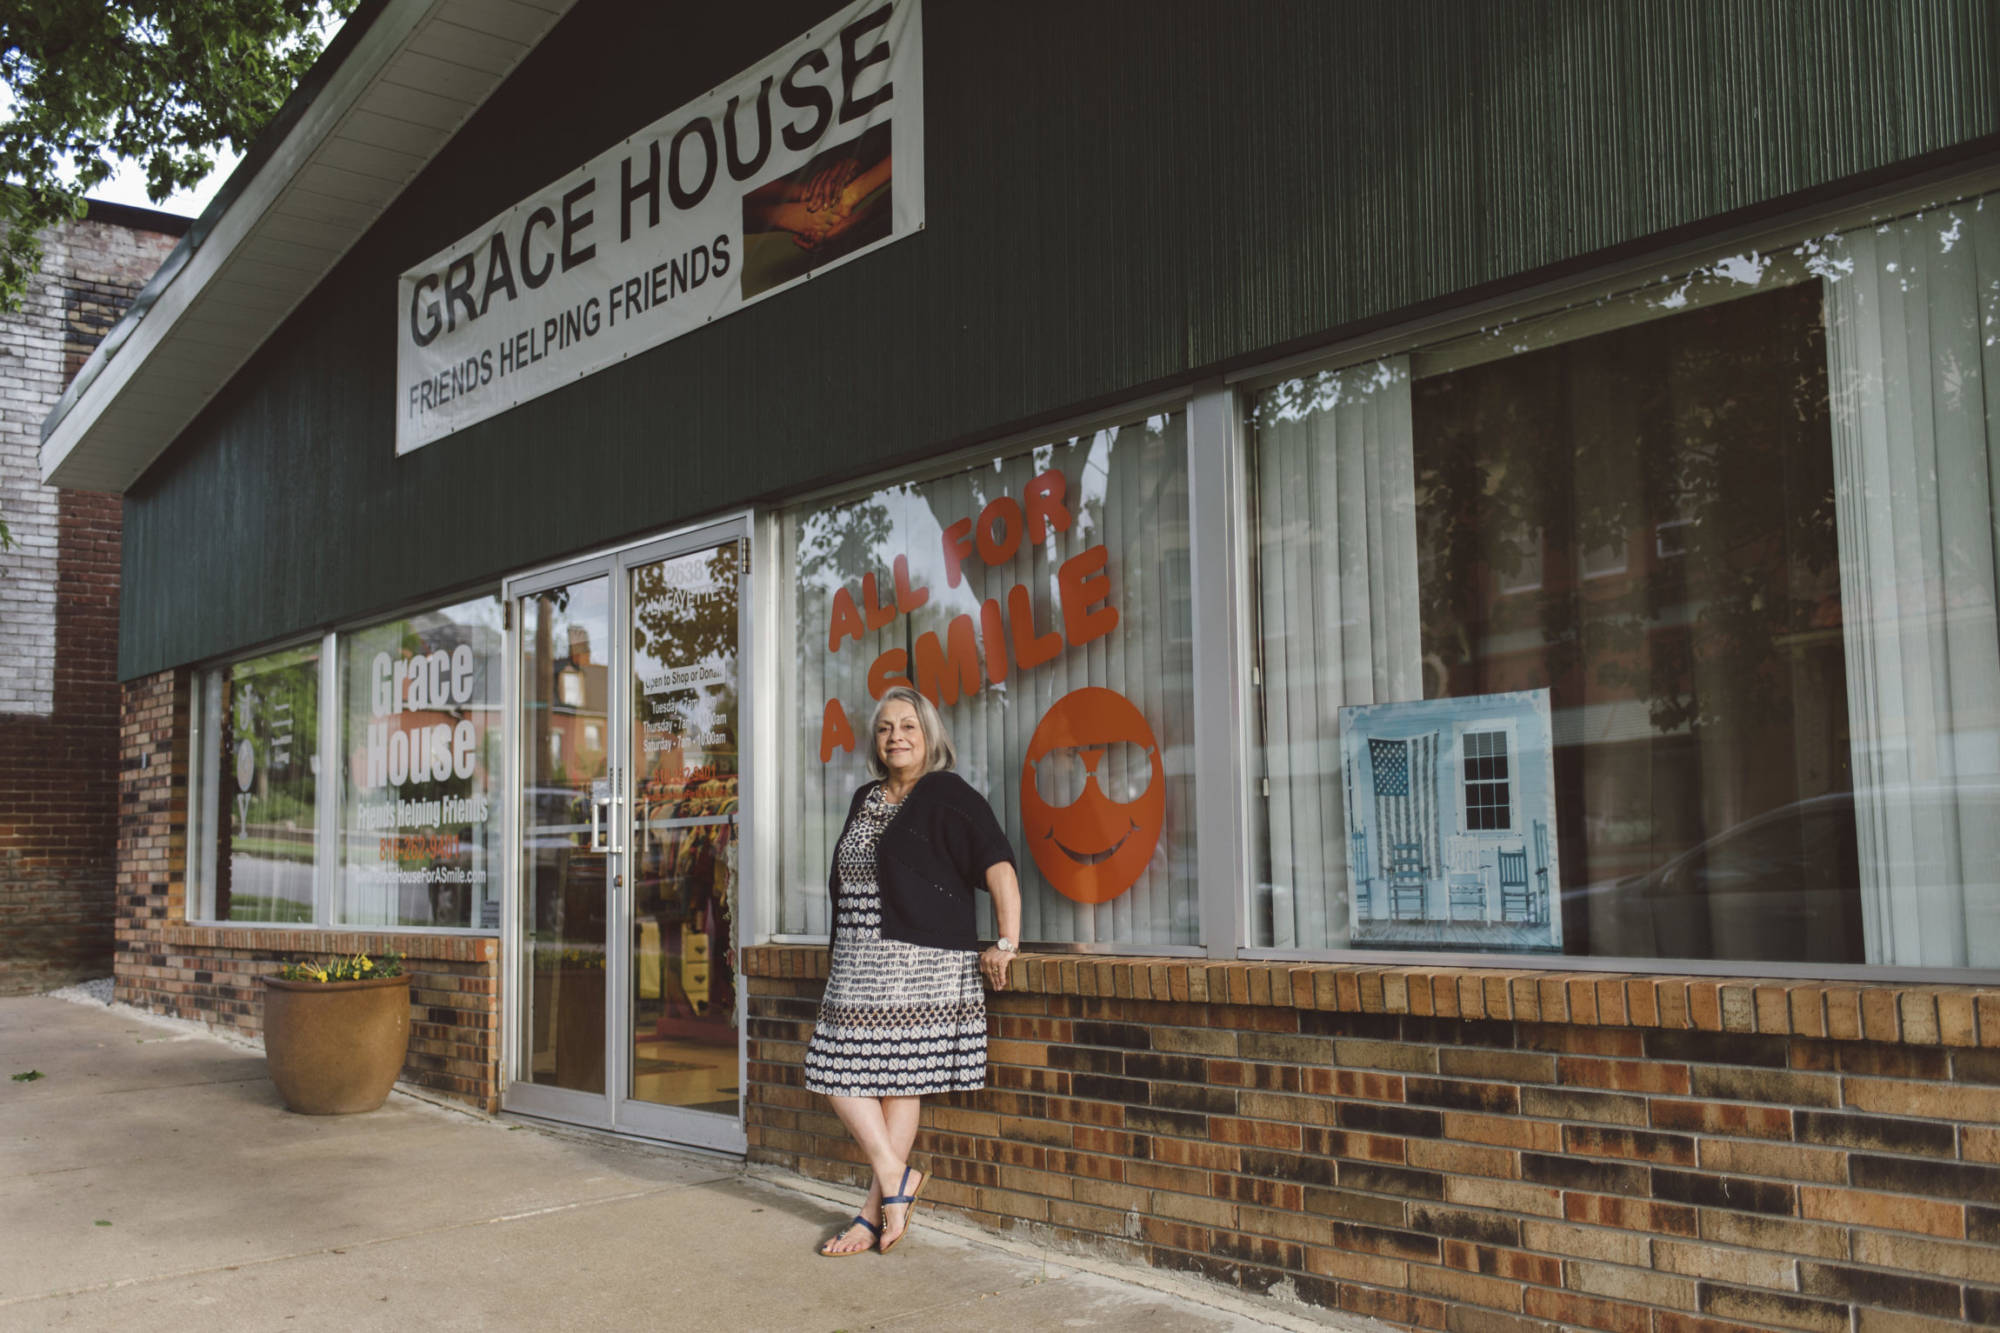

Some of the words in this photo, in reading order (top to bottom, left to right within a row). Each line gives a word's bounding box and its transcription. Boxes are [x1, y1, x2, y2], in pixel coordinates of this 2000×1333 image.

[410, 178, 597, 347] GRACE
[620, 3, 894, 242] HOUSE
[409, 349, 493, 419] FRIENDS
[499, 297, 601, 378] HELPING
[609, 234, 731, 327] FRIENDS
[667, 559, 704, 585] 2638
[828, 554, 929, 653] ALL
[942, 469, 1072, 589] FOR
[650, 587, 720, 615] LAFAYETTE
[820, 698, 855, 763] A
[868, 544, 1119, 711] SMILE
[372, 644, 474, 718] Grace
[663, 674, 671, 686] to
[671, 670, 690, 686] Shop
[690, 671, 699, 681] or
[652, 698, 678, 715] Tuesday
[643, 718, 673, 735] Thursday
[367, 719, 477, 788] House
[643, 735, 672, 752] Saturday
[357, 802, 396, 830] Friends
[398, 797, 441, 829] Helping
[442, 793, 489, 825] Friends
[379, 833, 460, 861] 816-262-9401
